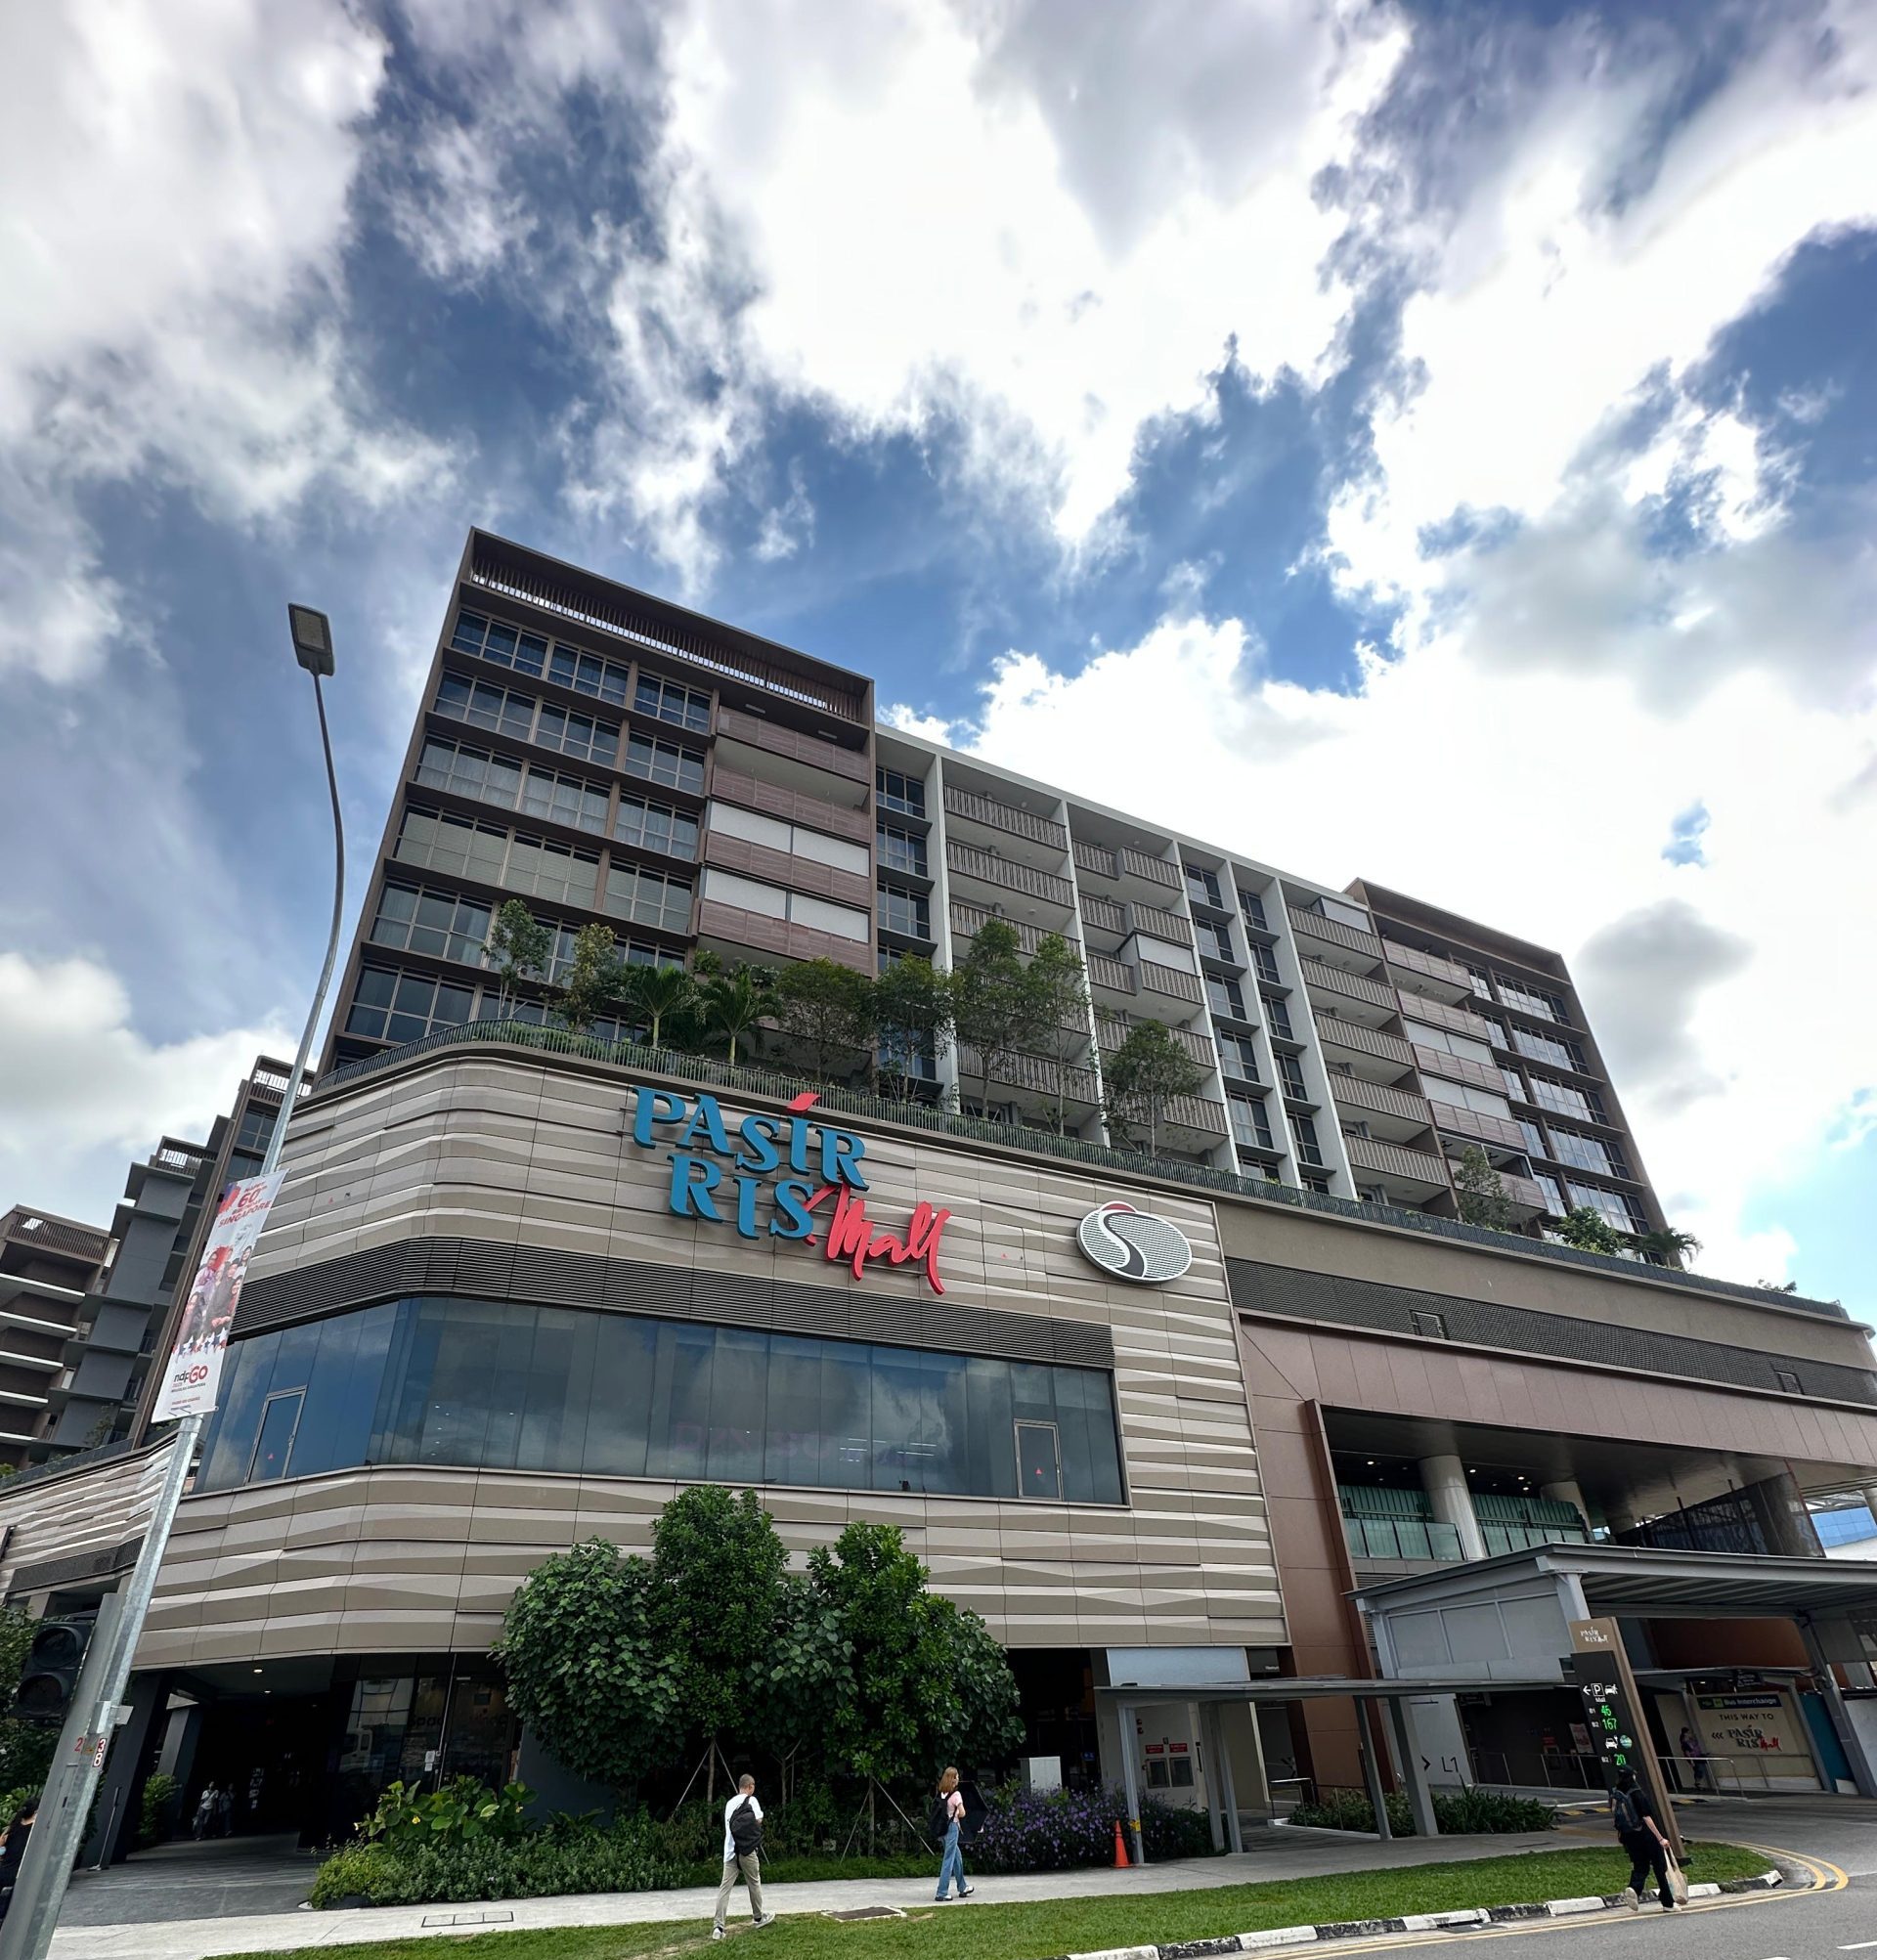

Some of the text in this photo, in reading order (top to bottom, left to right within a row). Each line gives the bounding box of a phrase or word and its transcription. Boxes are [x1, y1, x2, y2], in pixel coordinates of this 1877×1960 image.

[633, 1086, 870, 1191] PASIR
[218, 1200, 272, 1227] SINGAPORE
[667, 1153, 951, 1295] RIS Mall
[1602, 1718, 1617, 1730] 167
[1727, 1724, 1763, 1739] PASIR
[74, 1736, 84, 1752] 2
[1736, 1738, 1760, 1749] RIS
[1441, 1756, 1459, 1772] L1
